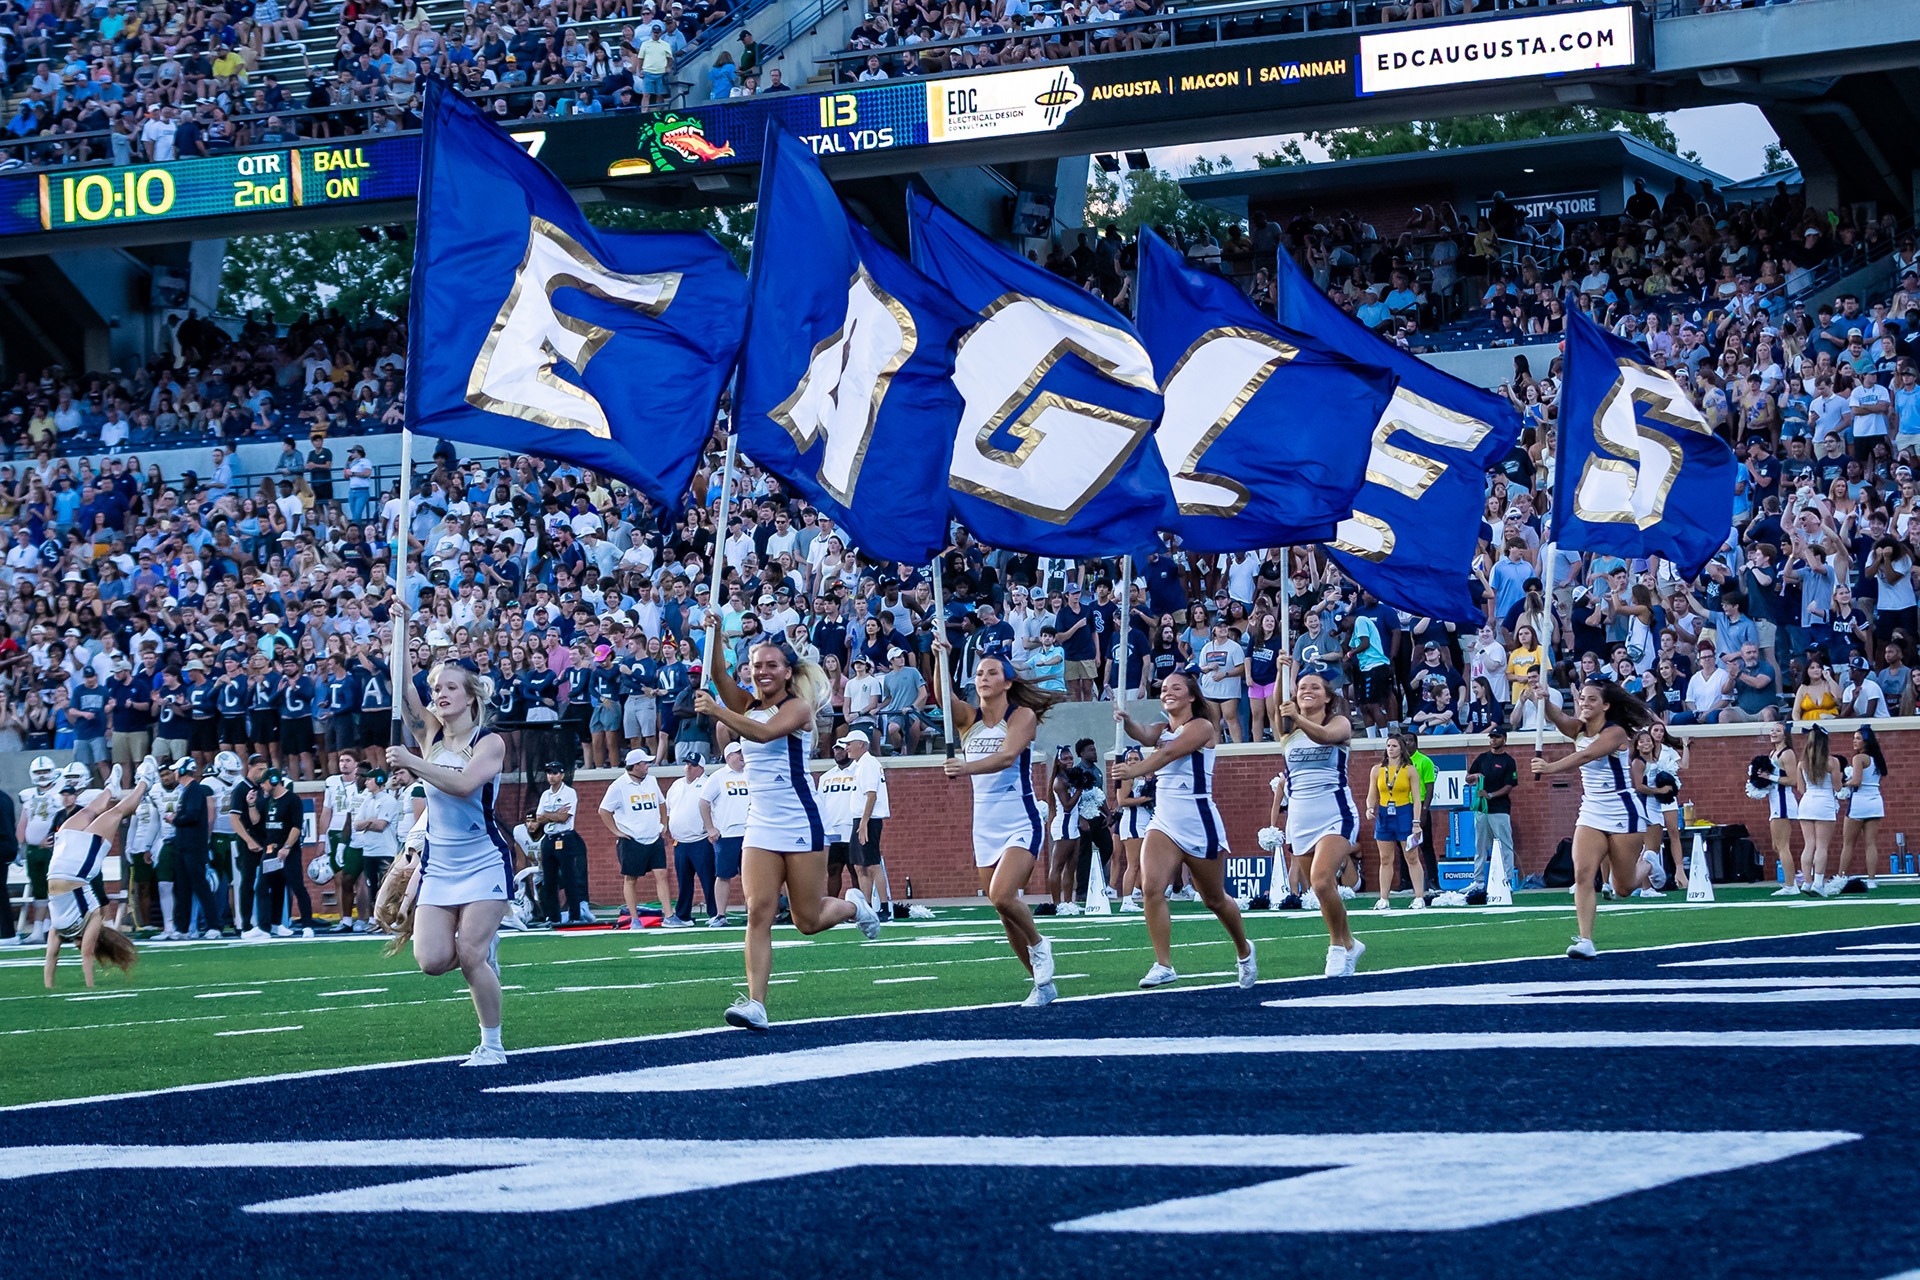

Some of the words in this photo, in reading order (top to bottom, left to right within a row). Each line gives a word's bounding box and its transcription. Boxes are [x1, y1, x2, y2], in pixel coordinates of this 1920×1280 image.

[1377, 28, 1614, 71] EDCAUGUSTA.COM
[1091, 79, 1161, 101] AUGUSTA
[1181, 71, 1239, 92] MACON
[1259, 59, 1347, 82] SAVANNAH
[819, 94, 859, 127] 113
[947, 88, 977, 115] EDC
[948, 112, 994, 125] ELECTRICAL
[995, 109, 1024, 120] DESIGN
[852, 128, 894, 151] YDS
[237, 153, 281, 175] QTR
[313, 146, 370, 172] BALL
[62, 168, 176, 223] 10:10
[233, 177, 288, 207] 2nd
[325, 176, 360, 199] ON
[1556, 197, 1596, 215] STORE
[362, 677, 382, 707] A
[1226, 858, 1266, 878] HOLD
